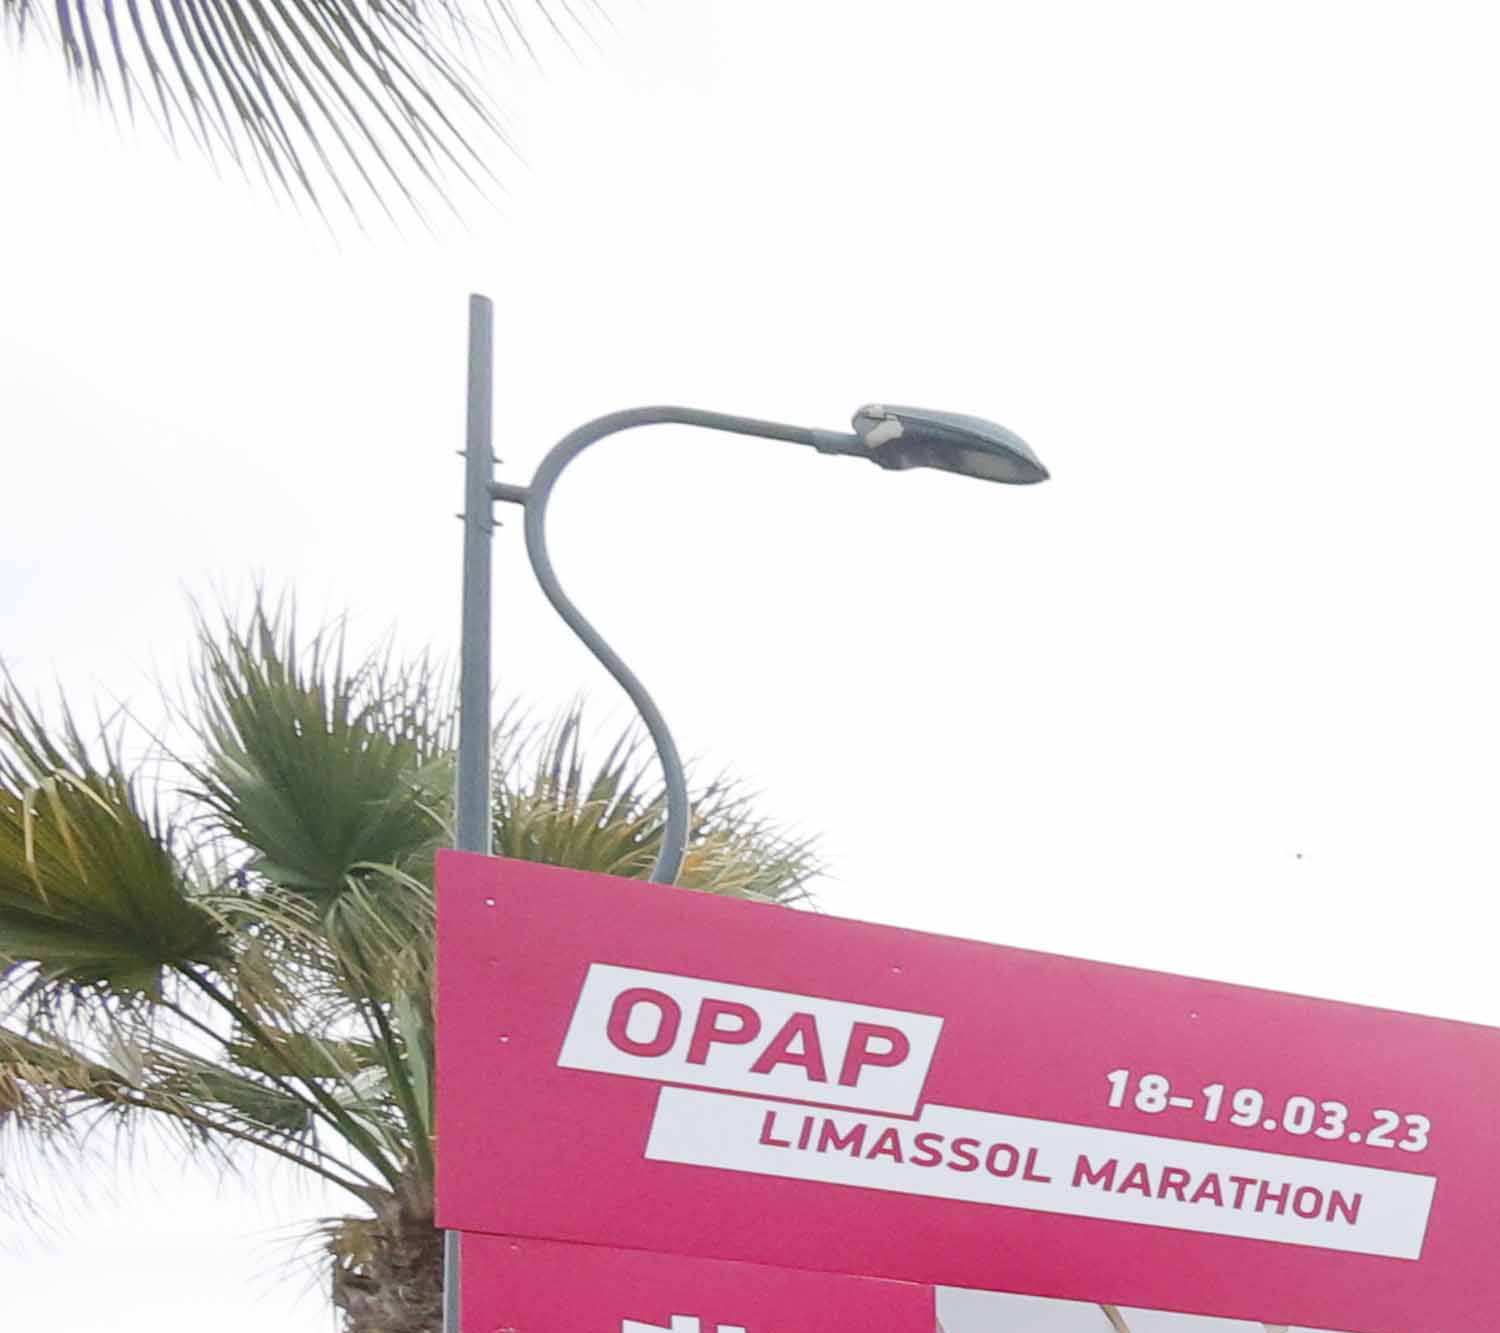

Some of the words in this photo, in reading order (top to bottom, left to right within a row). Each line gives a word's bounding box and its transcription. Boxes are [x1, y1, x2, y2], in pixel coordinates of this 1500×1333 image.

[606, 987, 911, 1088] OPAP
[1106, 1068, 1431, 1153] 18-19.03.23
[758, 1109, 1052, 1184] LIMASSOL
[1071, 1153, 1363, 1226] MARATHON
